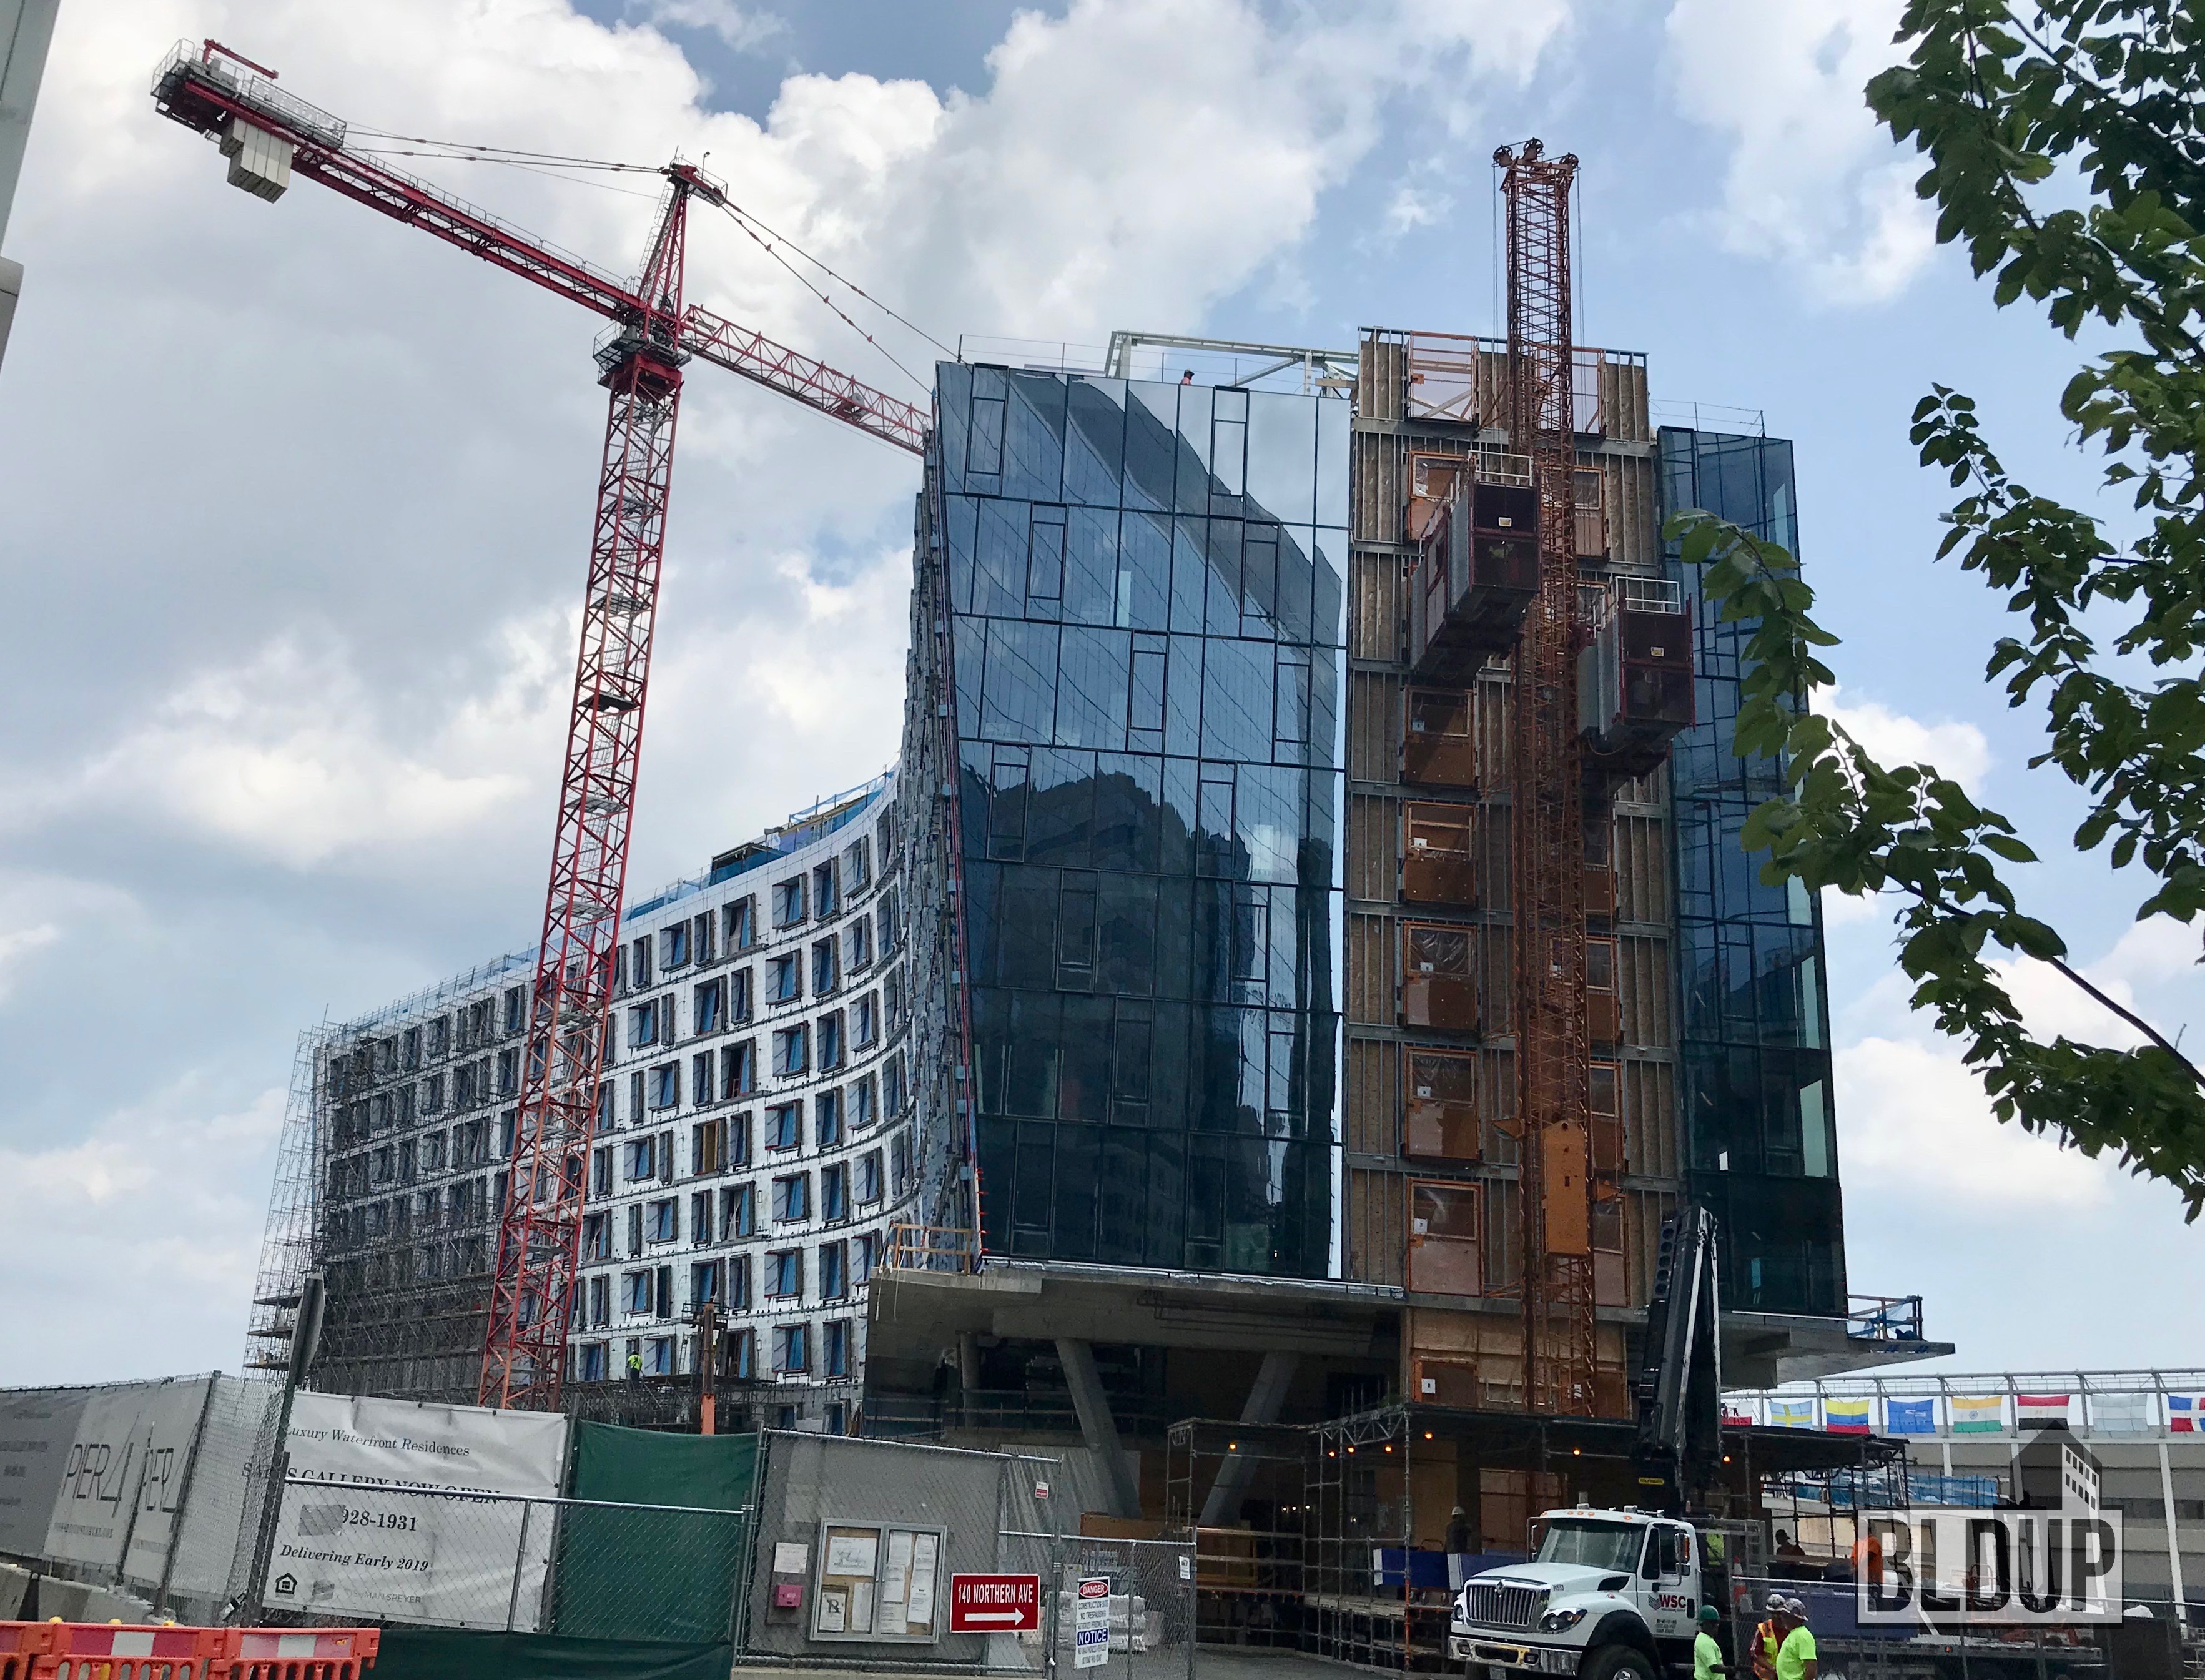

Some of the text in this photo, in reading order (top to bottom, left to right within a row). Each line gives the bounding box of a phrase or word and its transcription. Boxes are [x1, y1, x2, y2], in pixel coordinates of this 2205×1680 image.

[332, 1429, 398, 1449] Waterfront
[400, 1438, 470, 1456] Residences
[62, 1444, 111, 1500] PIER
[280, 1544, 429, 1572] Delivering Early 2019
[958, 1584, 1033, 1604] 140 NORTHERN AVE
[1082, 1584, 1105, 1595] DANGER
[1659, 1594, 1686, 1608] WSC
[1078, 1629, 1107, 1645] NOTICE
